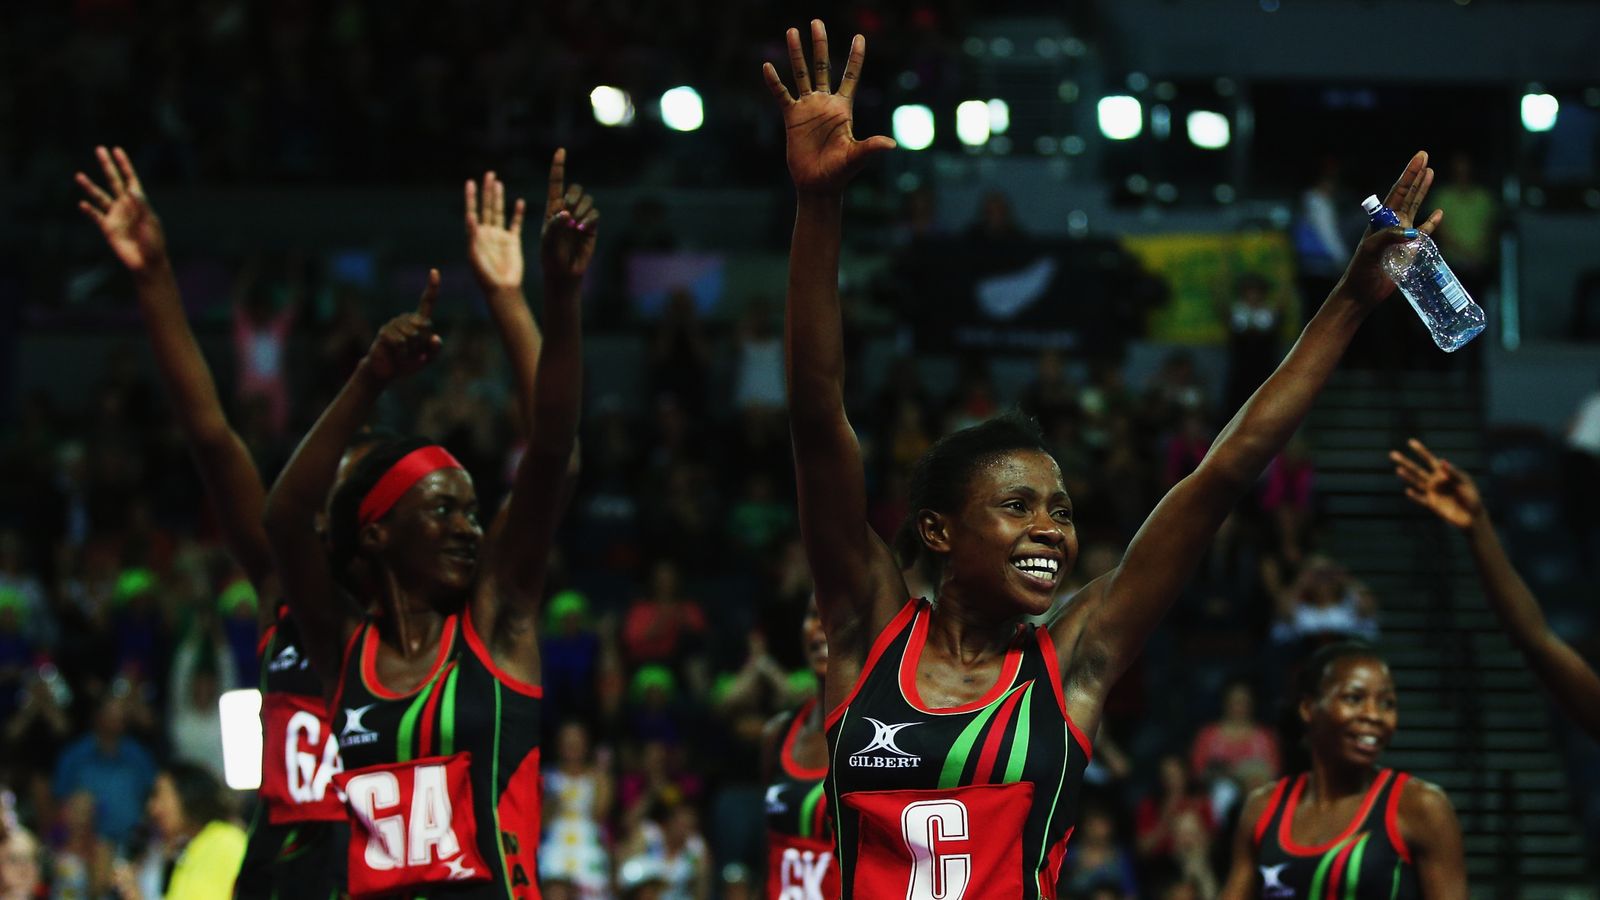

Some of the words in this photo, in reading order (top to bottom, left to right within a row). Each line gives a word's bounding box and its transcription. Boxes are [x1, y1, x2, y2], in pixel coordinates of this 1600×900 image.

[285, 711, 347, 803] GA
[848, 756, 921, 768] GILBERT
[346, 764, 460, 870] GA
[901, 799, 971, 900] C
